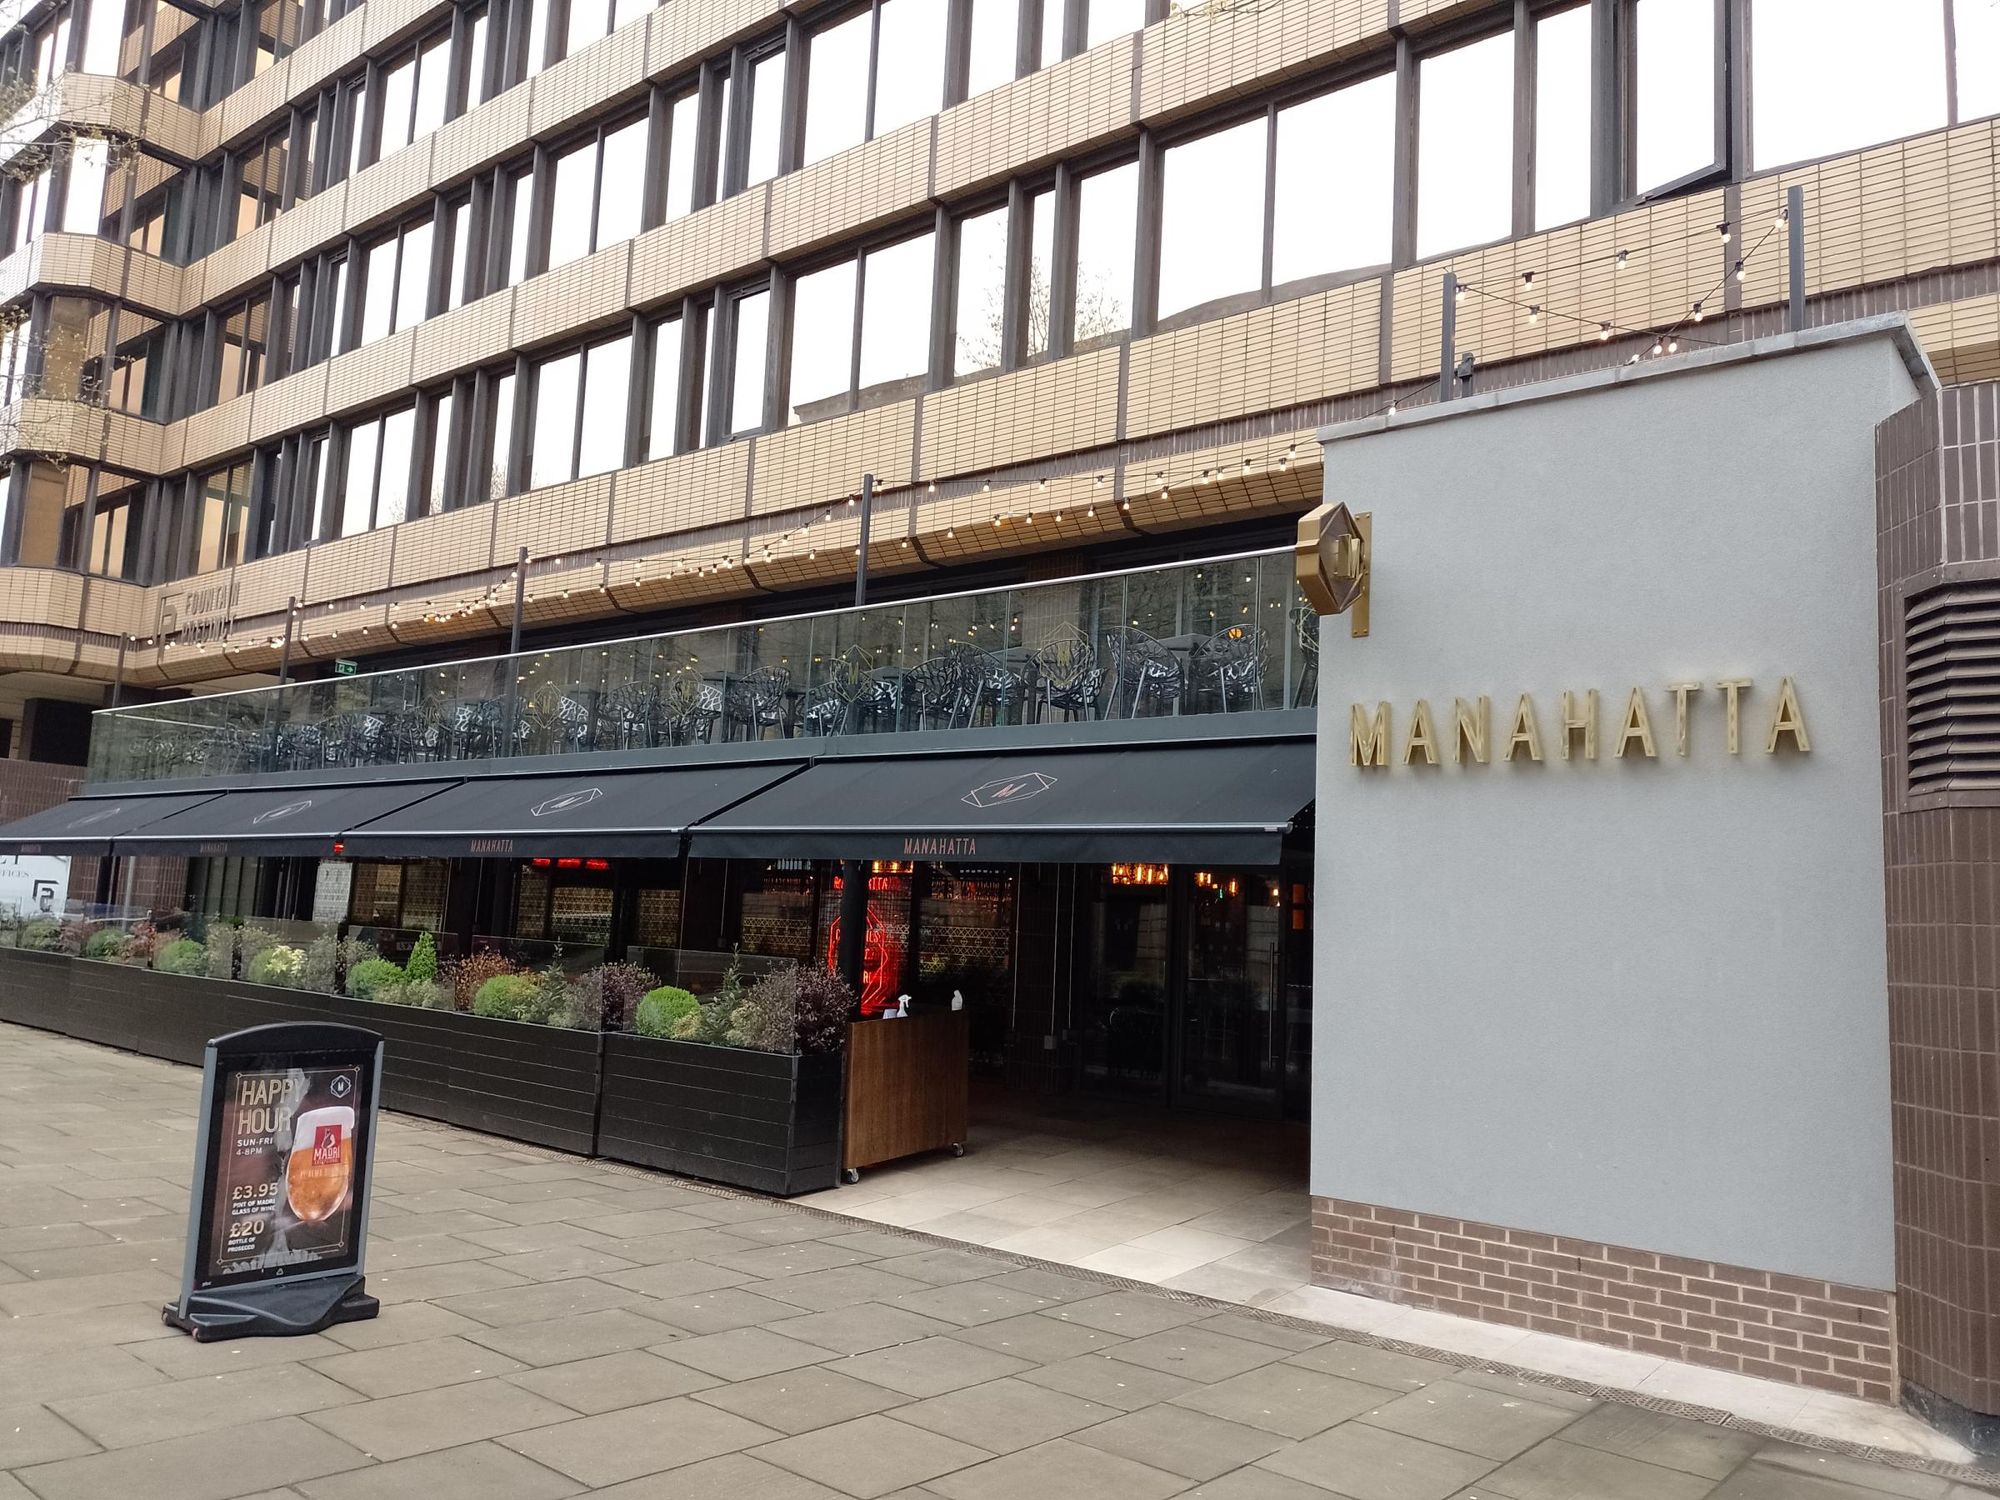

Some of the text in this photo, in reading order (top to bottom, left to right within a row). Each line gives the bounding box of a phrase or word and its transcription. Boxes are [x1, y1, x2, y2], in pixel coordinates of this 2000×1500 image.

[185, 582, 240, 615] FOUNTAIN
[181, 614, 237, 646] PRECINCT
[1350, 675, 1811, 767] MANAHATTA
[470, 840, 513, 852] MANAHATTA
[904, 838, 976, 855] MANAHATTA
[241, 1078, 302, 1106] HAPPY
[237, 1107, 292, 1135] HOUR
[236, 1137, 273, 1147] SUN-FRI
[236, 1147, 263, 1156] 4-8PM
[232, 1182, 279, 1200] £3.95
[229, 1219, 265, 1238] £20
[227, 1244, 255, 1252] PROSECCO
